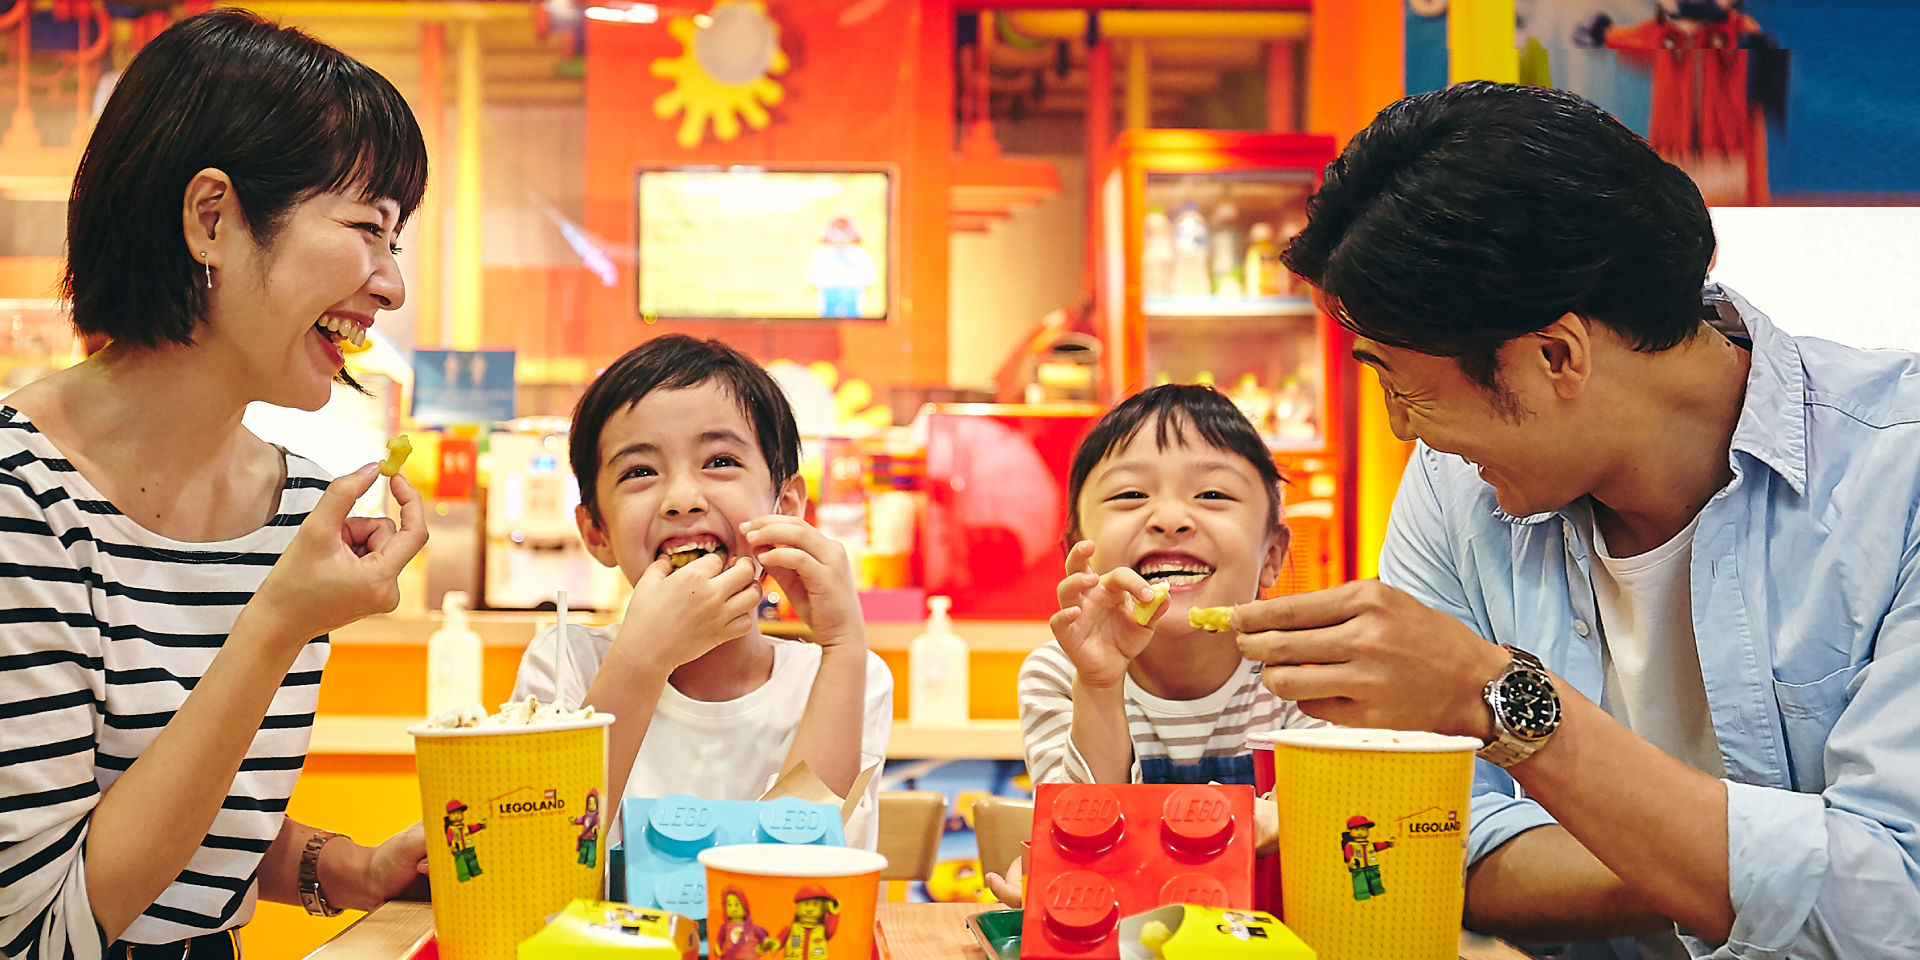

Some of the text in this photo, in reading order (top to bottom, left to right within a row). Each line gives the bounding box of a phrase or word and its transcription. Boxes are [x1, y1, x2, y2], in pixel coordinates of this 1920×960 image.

[500, 798, 564, 813] LEGOLAND
[1061, 799, 1113, 822] LEGO
[1170, 800, 1224, 822] LEGO
[658, 807, 710, 827] LEGO
[769, 810, 820, 830] LEGO
[1409, 821, 1460, 833] LEGOLAND
[665, 884, 705, 905] LEG
[1053, 887, 1106, 911] LEGO
